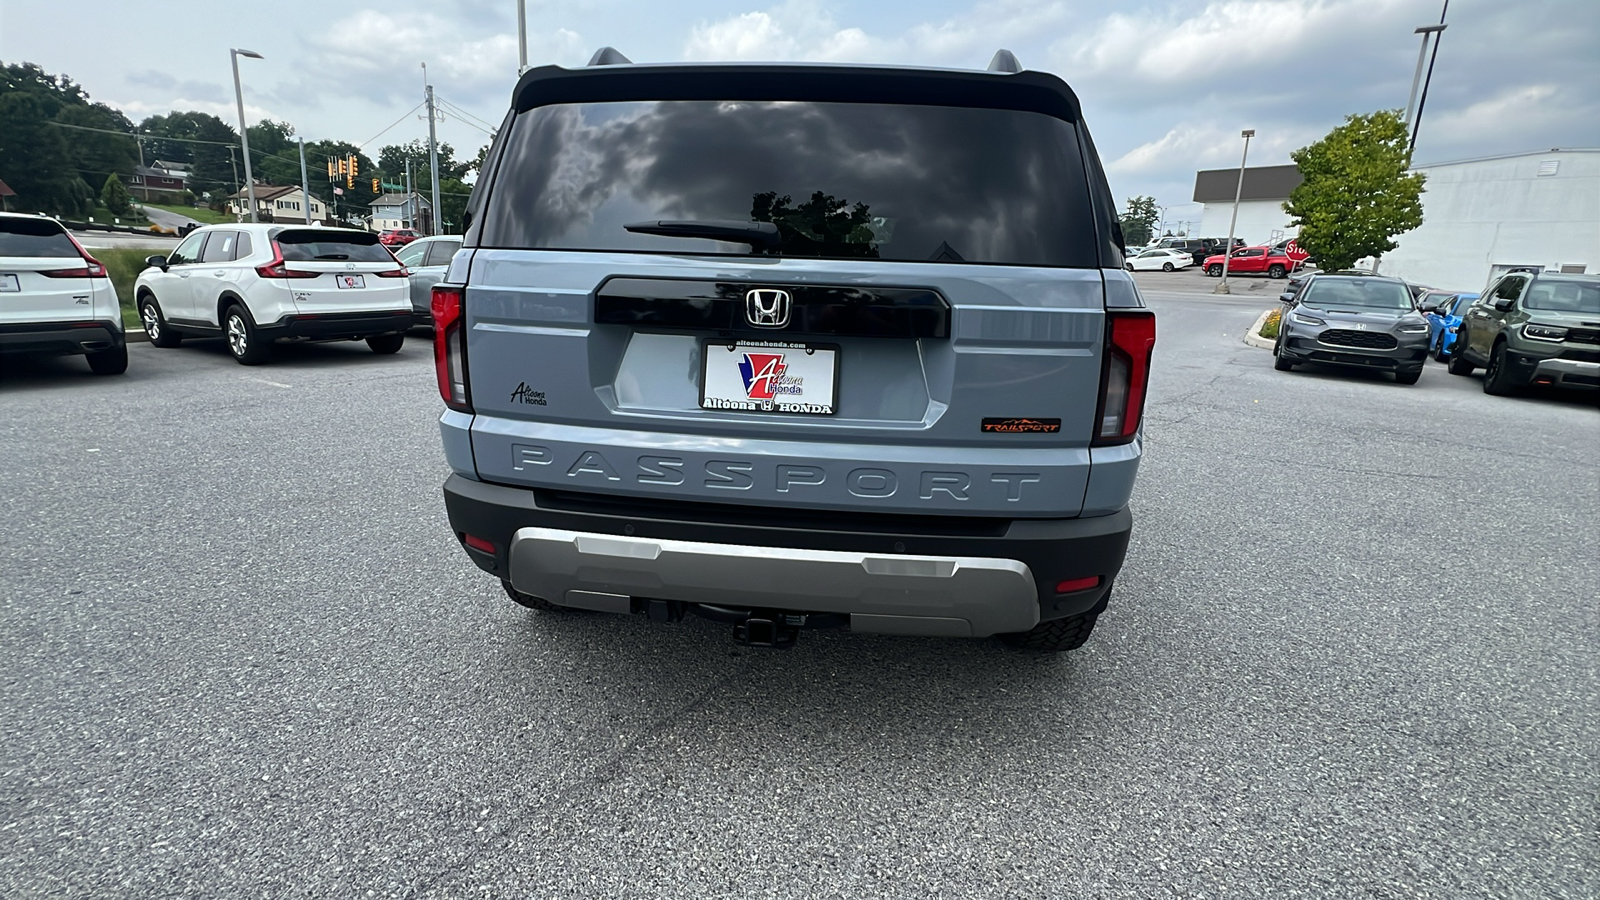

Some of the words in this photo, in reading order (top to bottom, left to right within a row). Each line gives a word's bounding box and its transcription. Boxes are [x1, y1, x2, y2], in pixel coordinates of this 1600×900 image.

[1287, 243, 1307, 254] STO
[736, 340, 806, 349] altoonahonda.com
[769, 383, 801, 394] Honda
[525, 397, 547, 406] Honda
[703, 398, 756, 410] Altoona
[779, 403, 833, 414] HONDA
[984, 424, 1059, 432] TRAILSPORT
[511, 443, 1041, 501] PASSPORT
